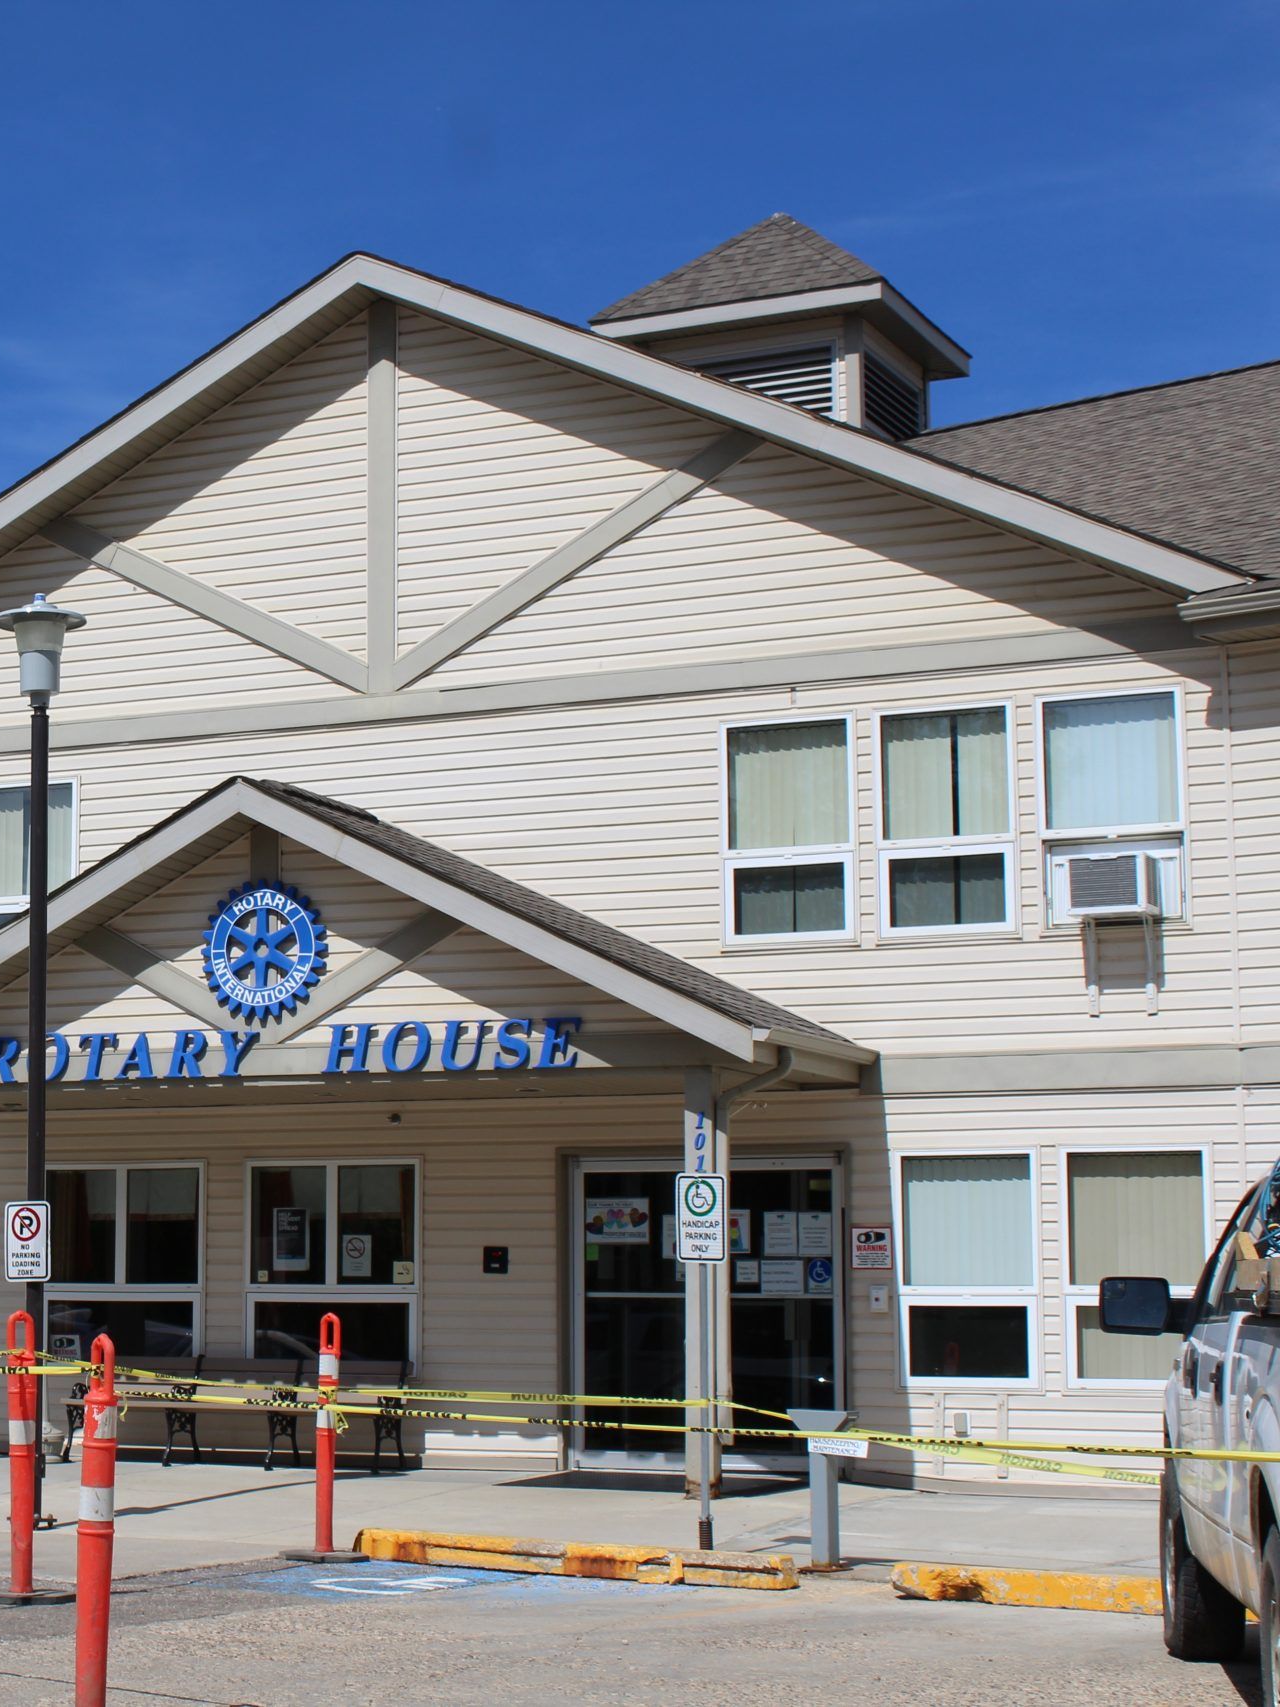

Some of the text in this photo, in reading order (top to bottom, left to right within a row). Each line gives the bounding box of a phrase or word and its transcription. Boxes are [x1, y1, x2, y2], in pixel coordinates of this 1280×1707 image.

[231, 892, 297, 916] ROTARY
[213, 958, 309, 1004] INTERNATIONAL
[321, 1017, 583, 1073] HOUSE
[694, 1111, 706, 1172] 101
[682, 1220, 720, 1229] HANDICAP
[685, 1232, 718, 1241] PARKING
[691, 1244, 710, 1253] ONLY
[856, 1244, 888, 1252] WARNING
